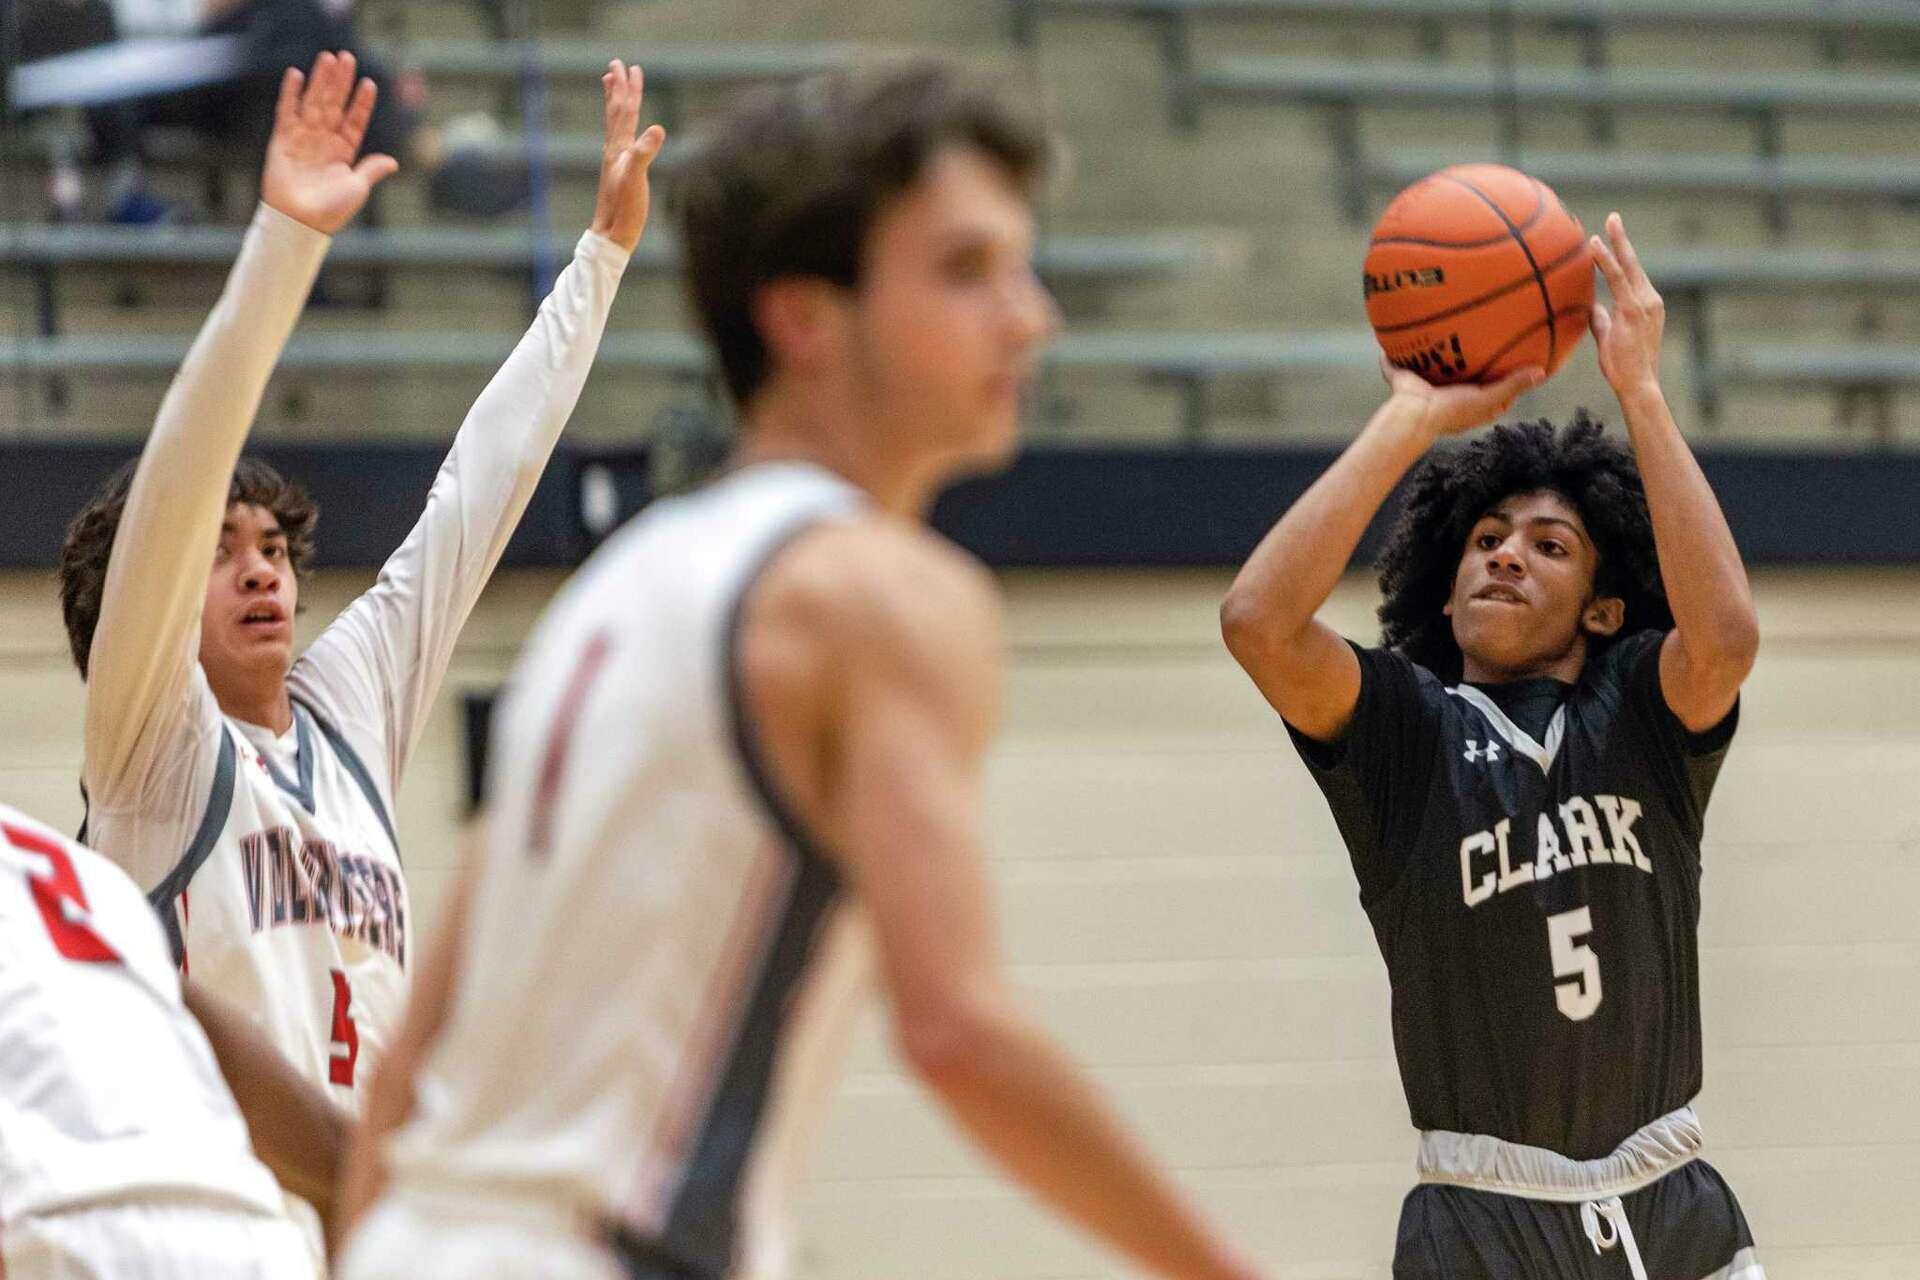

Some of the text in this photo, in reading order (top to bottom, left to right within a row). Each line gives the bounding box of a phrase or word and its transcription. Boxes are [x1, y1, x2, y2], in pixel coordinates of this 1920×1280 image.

[1, 822, 126, 965] 2
[1460, 795, 1653, 908] CLARK
[1547, 905, 1603, 1022] 5
